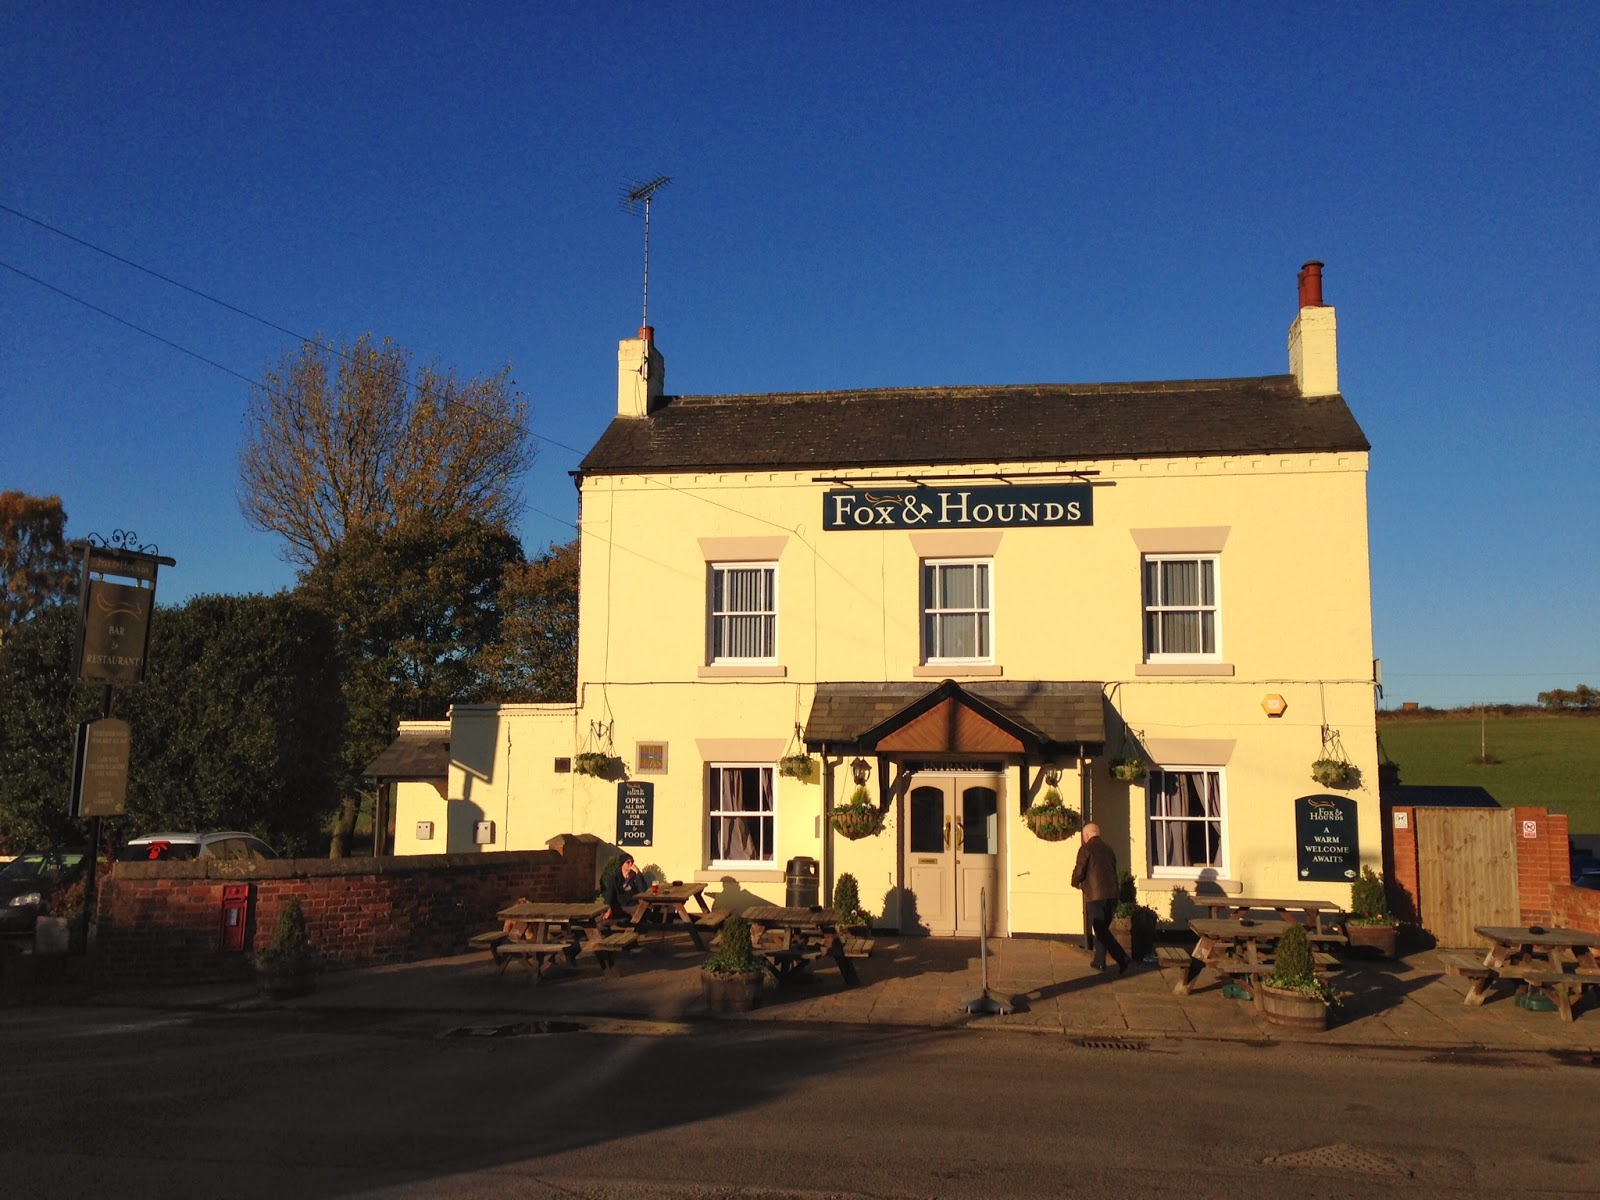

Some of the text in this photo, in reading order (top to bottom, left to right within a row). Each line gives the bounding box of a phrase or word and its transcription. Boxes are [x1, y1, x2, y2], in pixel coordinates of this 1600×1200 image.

[832, 492, 1081, 525] FOX & HOUNDS
[108, 625, 125, 636] BAR
[86, 654, 140, 667] RESTAURANT
[923, 761, 985, 772] ENTRANCE
[1310, 812, 1344, 821] HOUNDS
[1305, 845, 1350, 853] WELCOME
[1312, 855, 1343, 863] AWAITS
